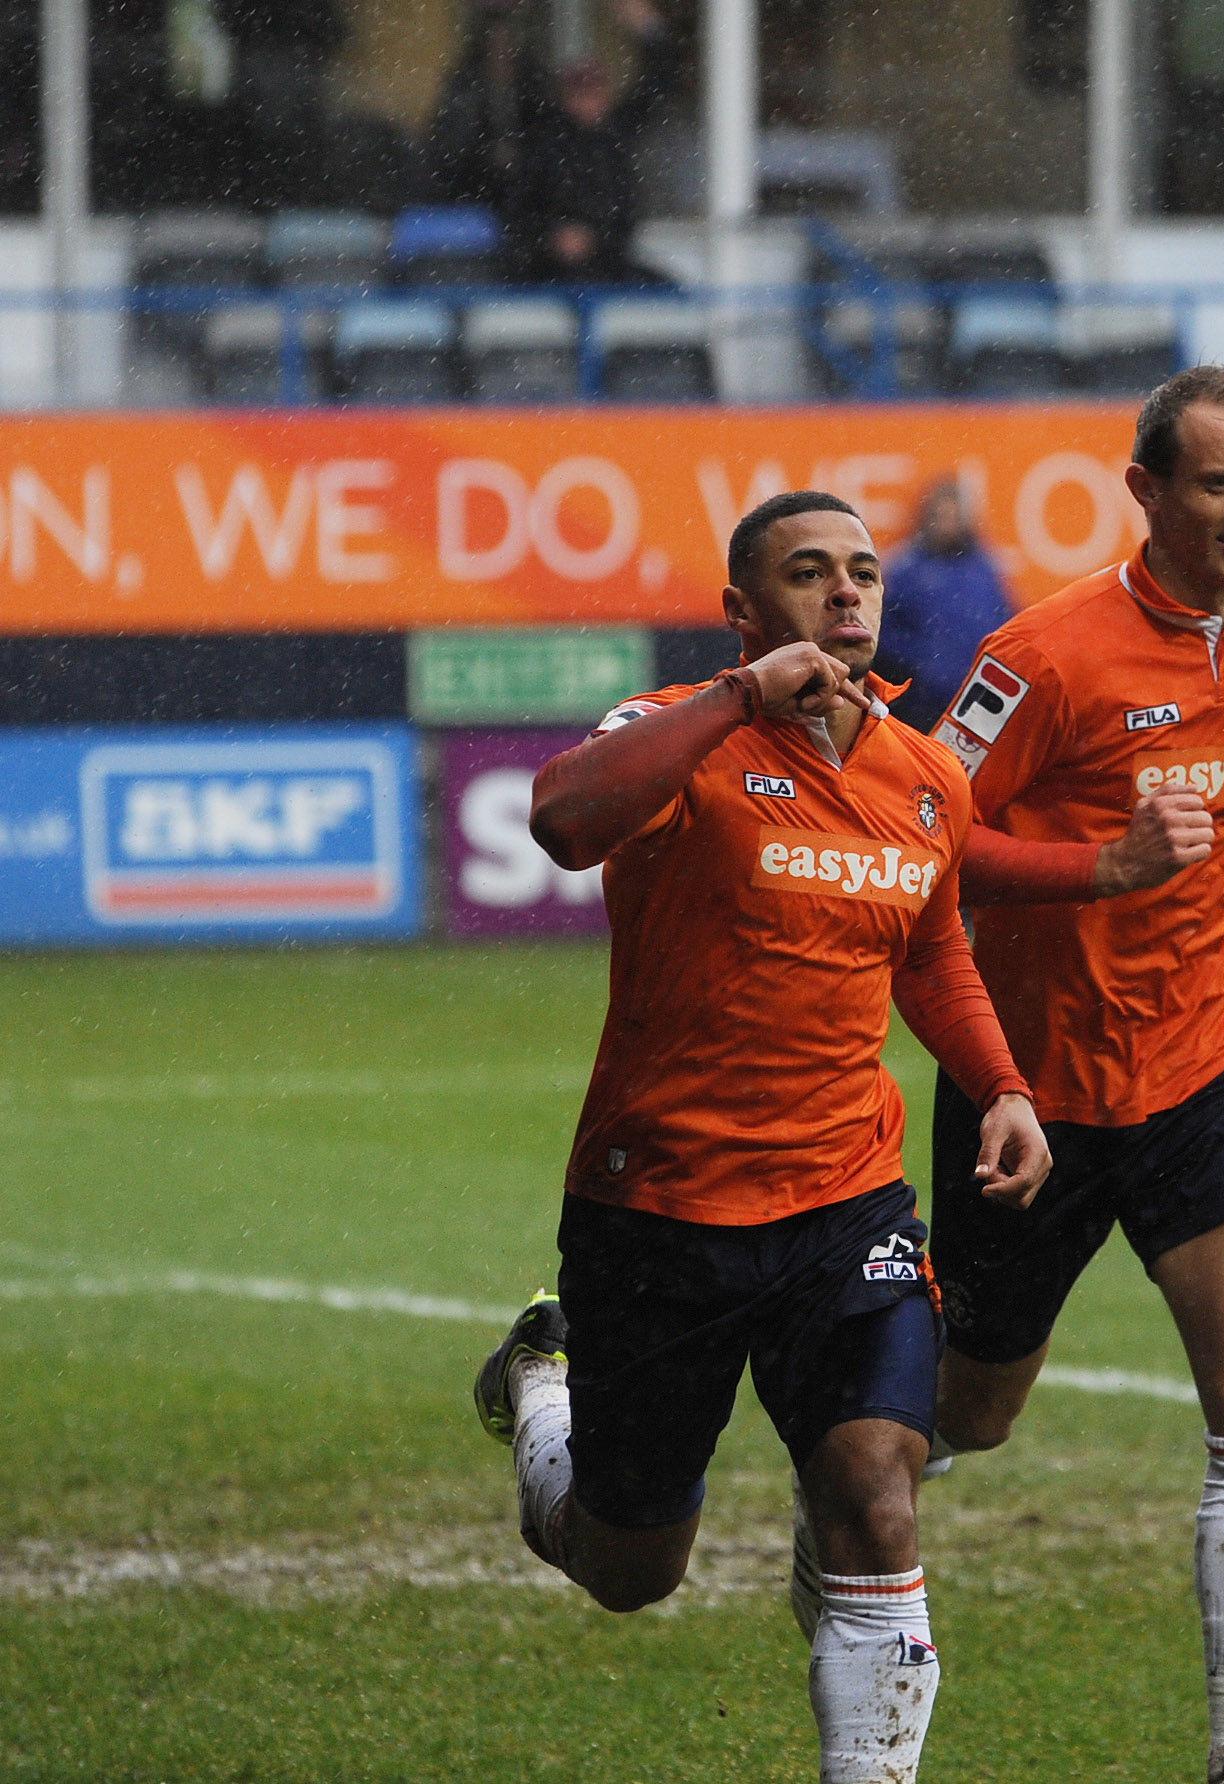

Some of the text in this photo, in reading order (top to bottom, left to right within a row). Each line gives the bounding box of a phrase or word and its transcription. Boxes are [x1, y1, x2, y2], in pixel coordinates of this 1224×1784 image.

[0, 461, 144, 596] N,
[172, 459, 399, 583] WE
[434, 455, 671, 589] DO,
[1131, 707, 1176, 728] FILA
[749, 775, 792, 796] FILA
[120, 781, 365, 857] SKF
[760, 842, 938, 899] easyJet
[868, 1262, 914, 1279] FILA
